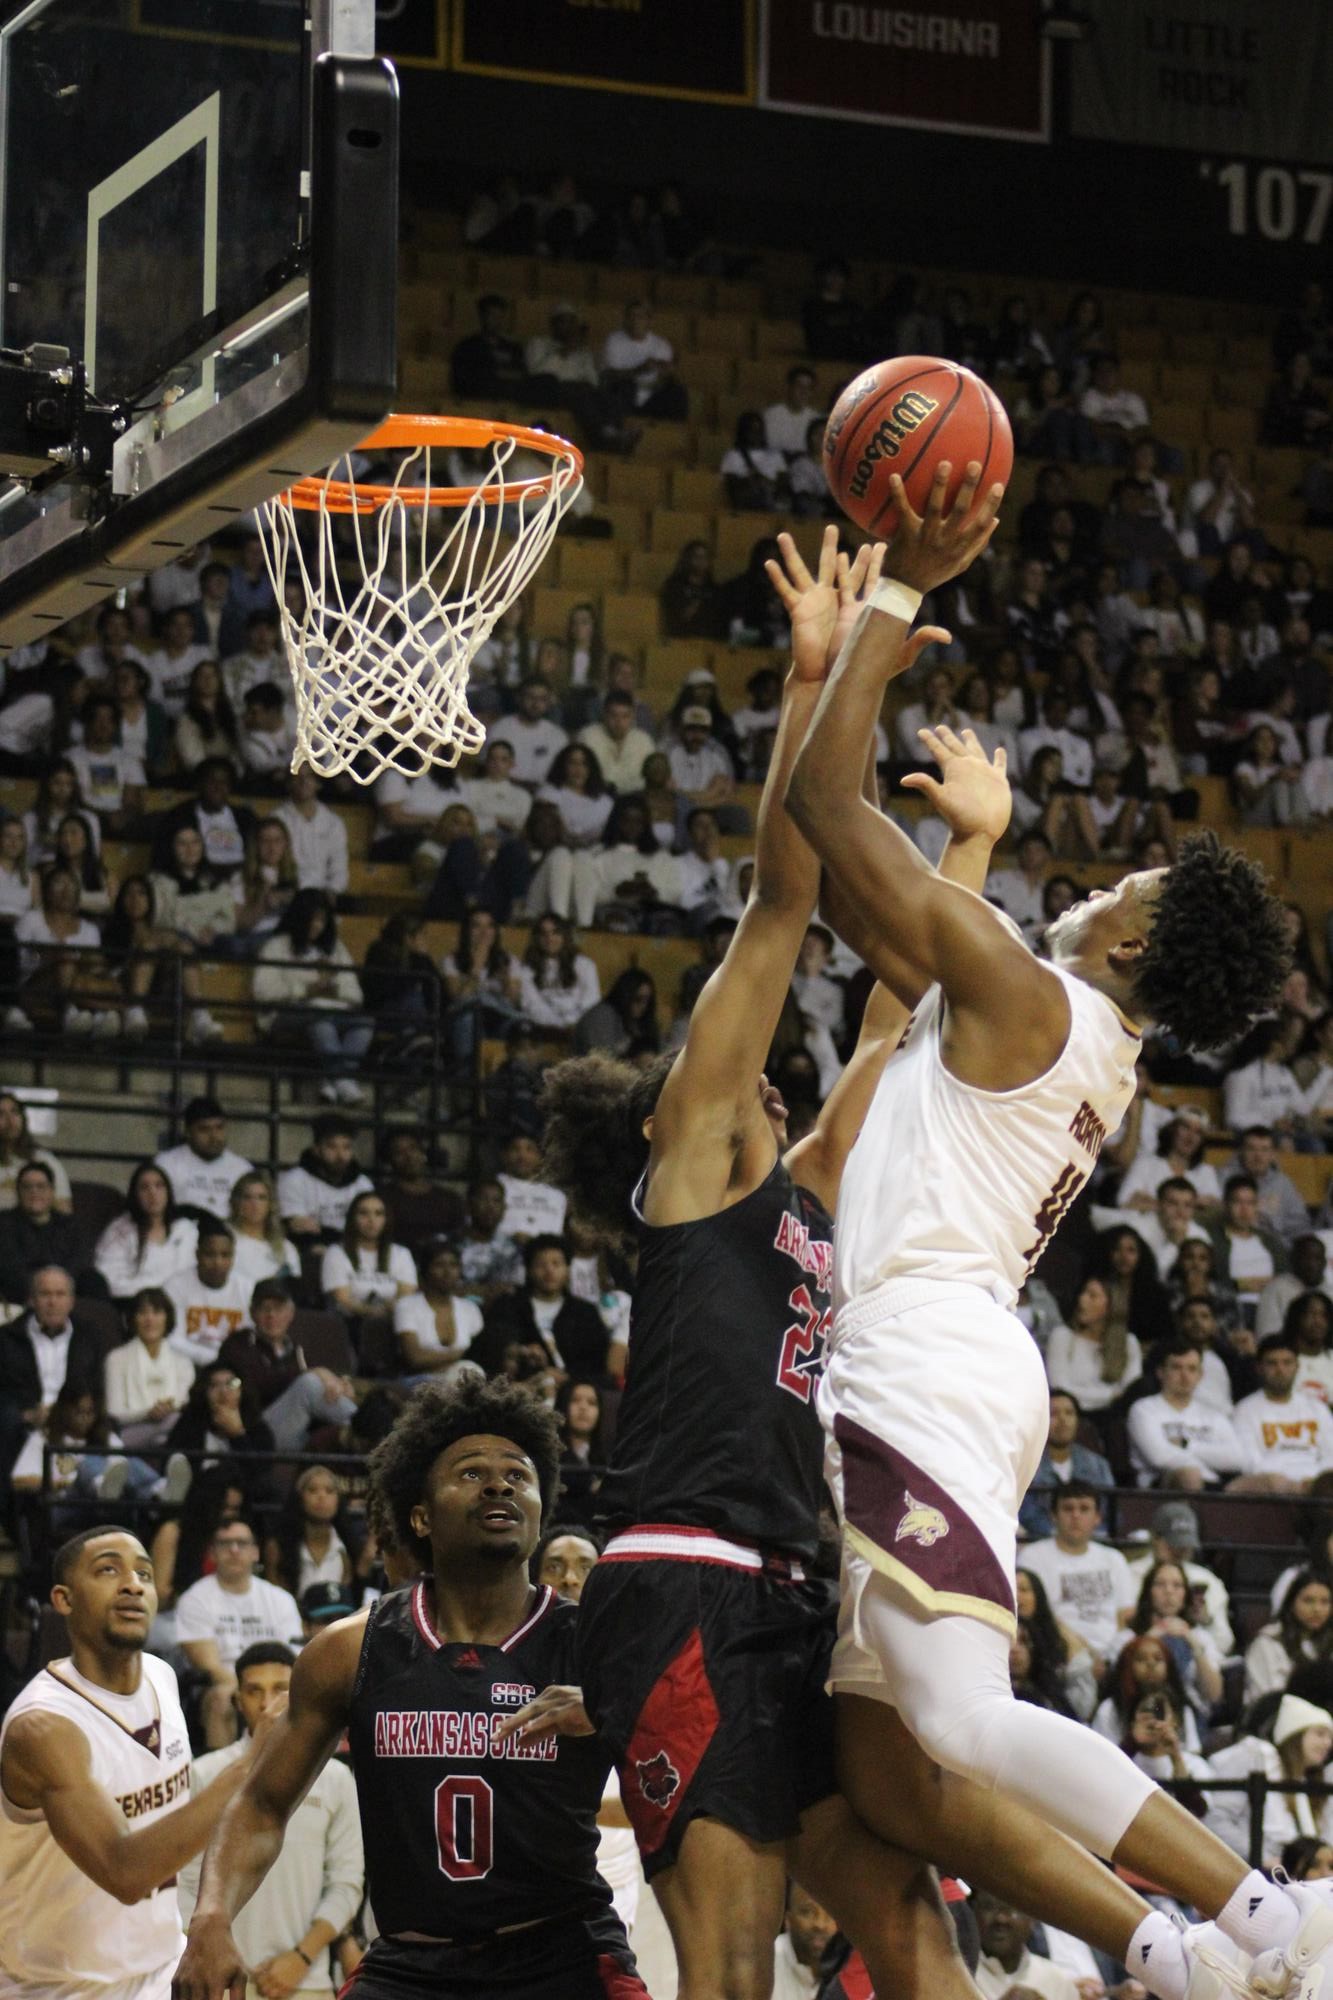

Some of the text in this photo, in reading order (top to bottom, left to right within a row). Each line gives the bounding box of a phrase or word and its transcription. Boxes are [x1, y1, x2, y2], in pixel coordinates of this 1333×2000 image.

[812, 0, 1000, 59] LOUISIANA
[1146, 17, 1258, 63] LITTLE
[1157, 67, 1248, 108] ROCK
[850, 391, 939, 499] Wilson
[491, 1683, 536, 1706] SBC
[375, 1711, 488, 1760] ARKANSAS
[115, 1784, 164, 1818] EXAS
[434, 1774, 494, 1882] 0
